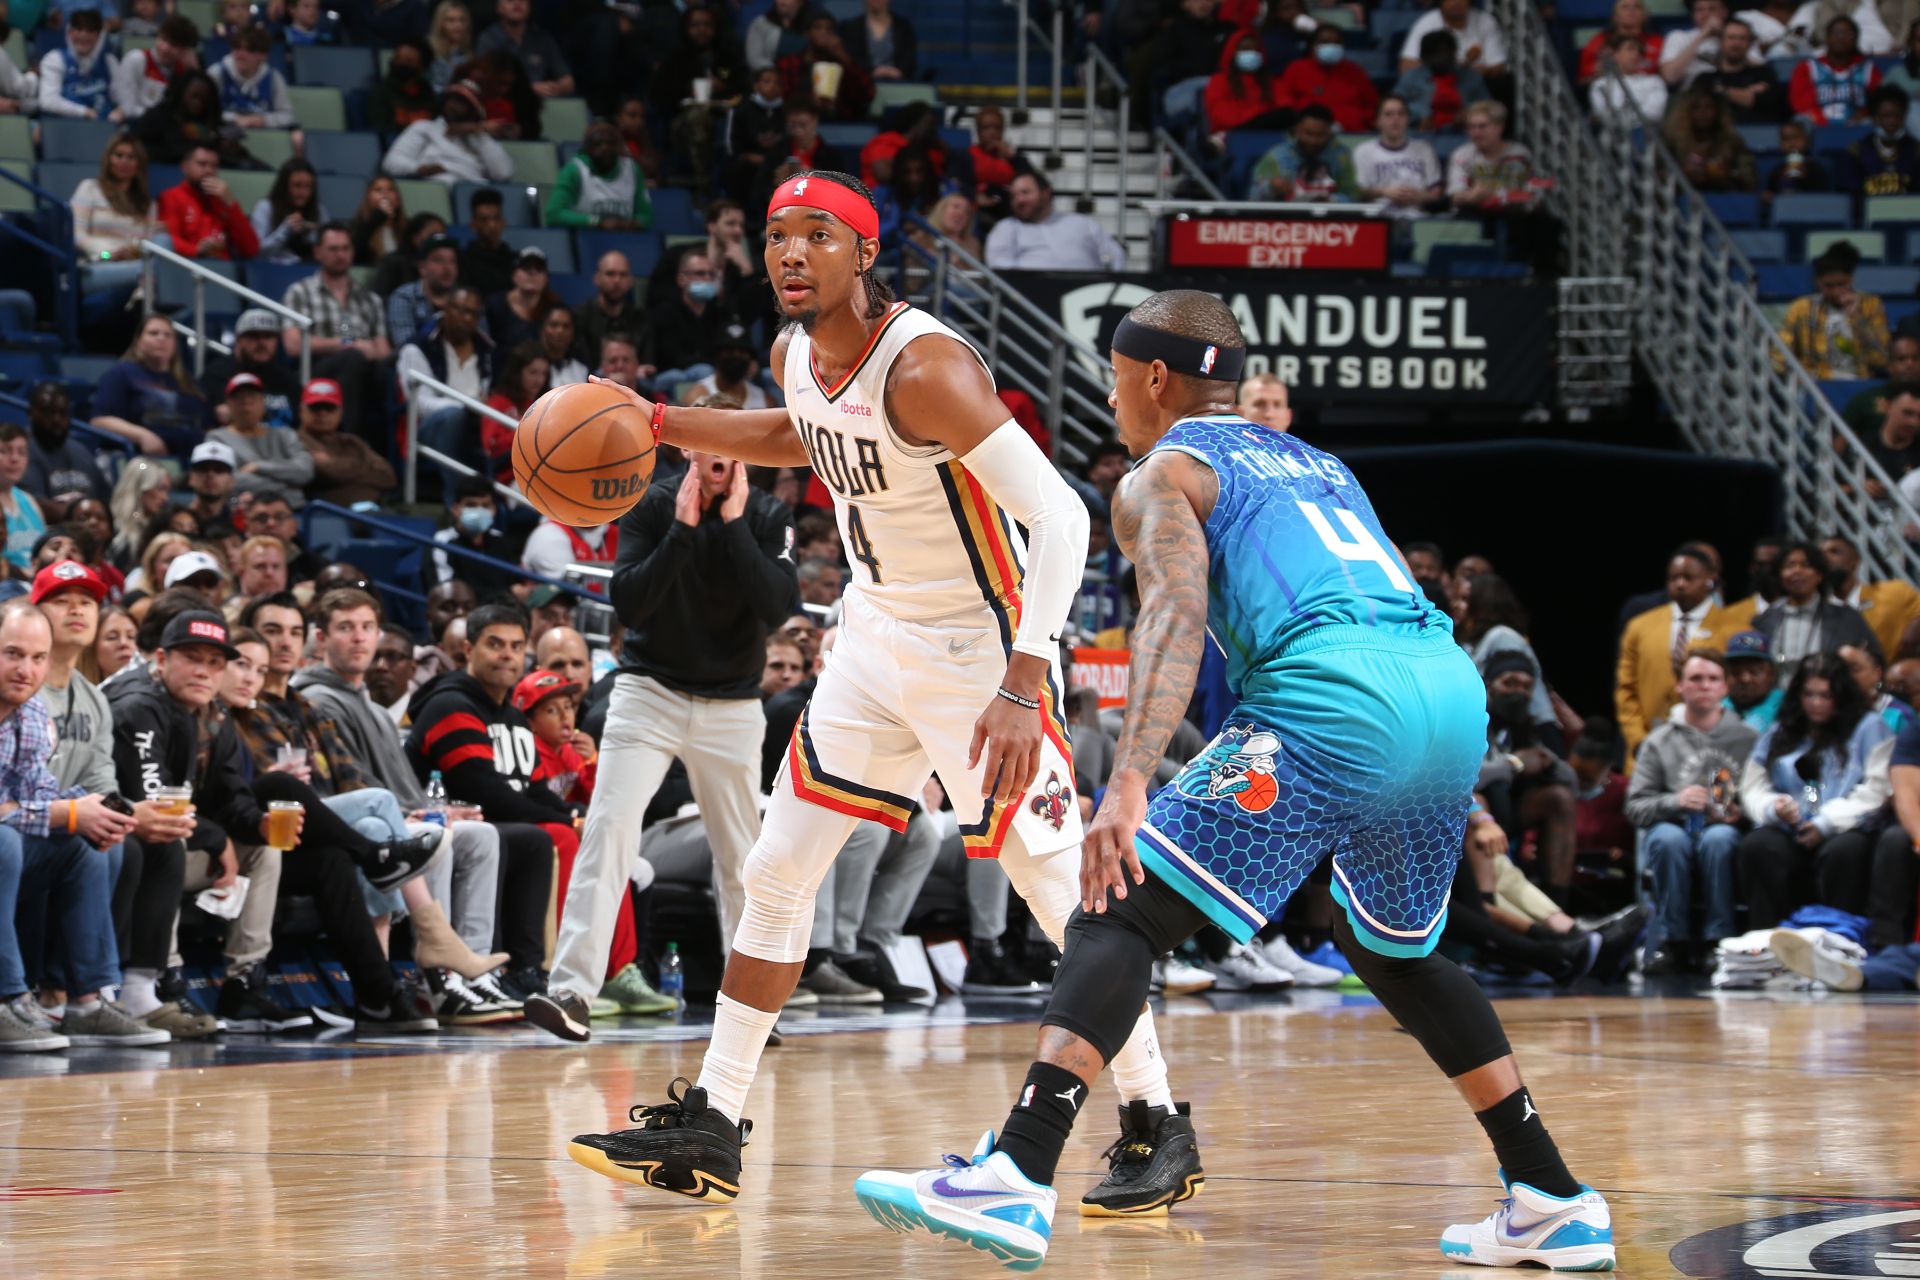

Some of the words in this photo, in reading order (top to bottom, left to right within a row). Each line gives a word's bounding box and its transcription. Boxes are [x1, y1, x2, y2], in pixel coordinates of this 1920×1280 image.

[1197, 221, 1360, 246] EMERGENCY
[1248, 246, 1308, 268] EXIT
[1217, 293, 1488, 349] ANDUEL
[1244, 354, 1488, 389] ORTSBOOK
[840, 400, 872, 417] ibotta
[798, 415, 890, 498] NOLA
[848, 502, 885, 585] 4
[1295, 499, 1415, 593] 4
